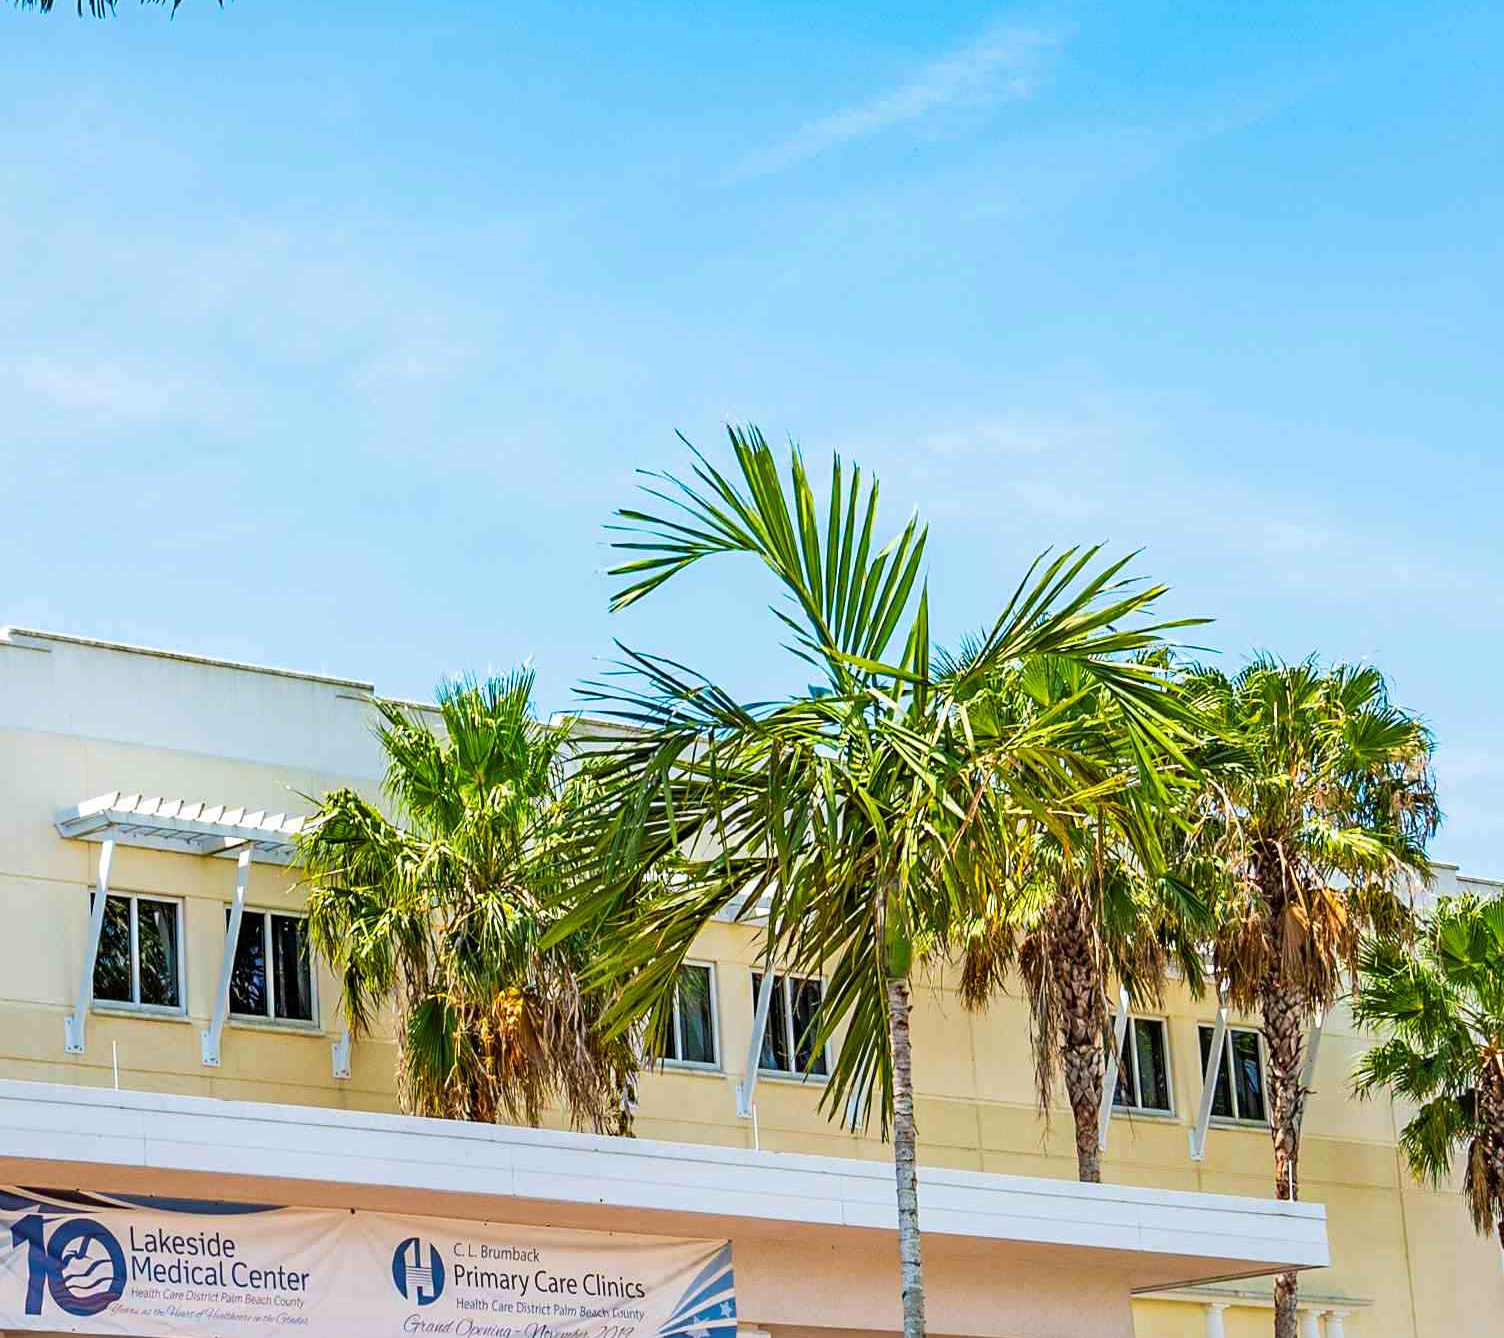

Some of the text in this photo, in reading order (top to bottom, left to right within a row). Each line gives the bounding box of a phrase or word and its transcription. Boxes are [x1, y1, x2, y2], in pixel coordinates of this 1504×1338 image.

[129, 1225, 236, 1259] Lakeside
[453, 1242, 540, 1262] C. L. Brumback
[10, 1214, 128, 1317] 10
[131, 1255, 310, 1292] Medical Center
[454, 1263, 646, 1299] Primary Care Clinics
[130, 1288, 305, 1309] Health Care District Palm Beach County
[456, 1297, 644, 1322] Health Care District Palm Beach County
[402, 1313, 455, 1336] Grand
